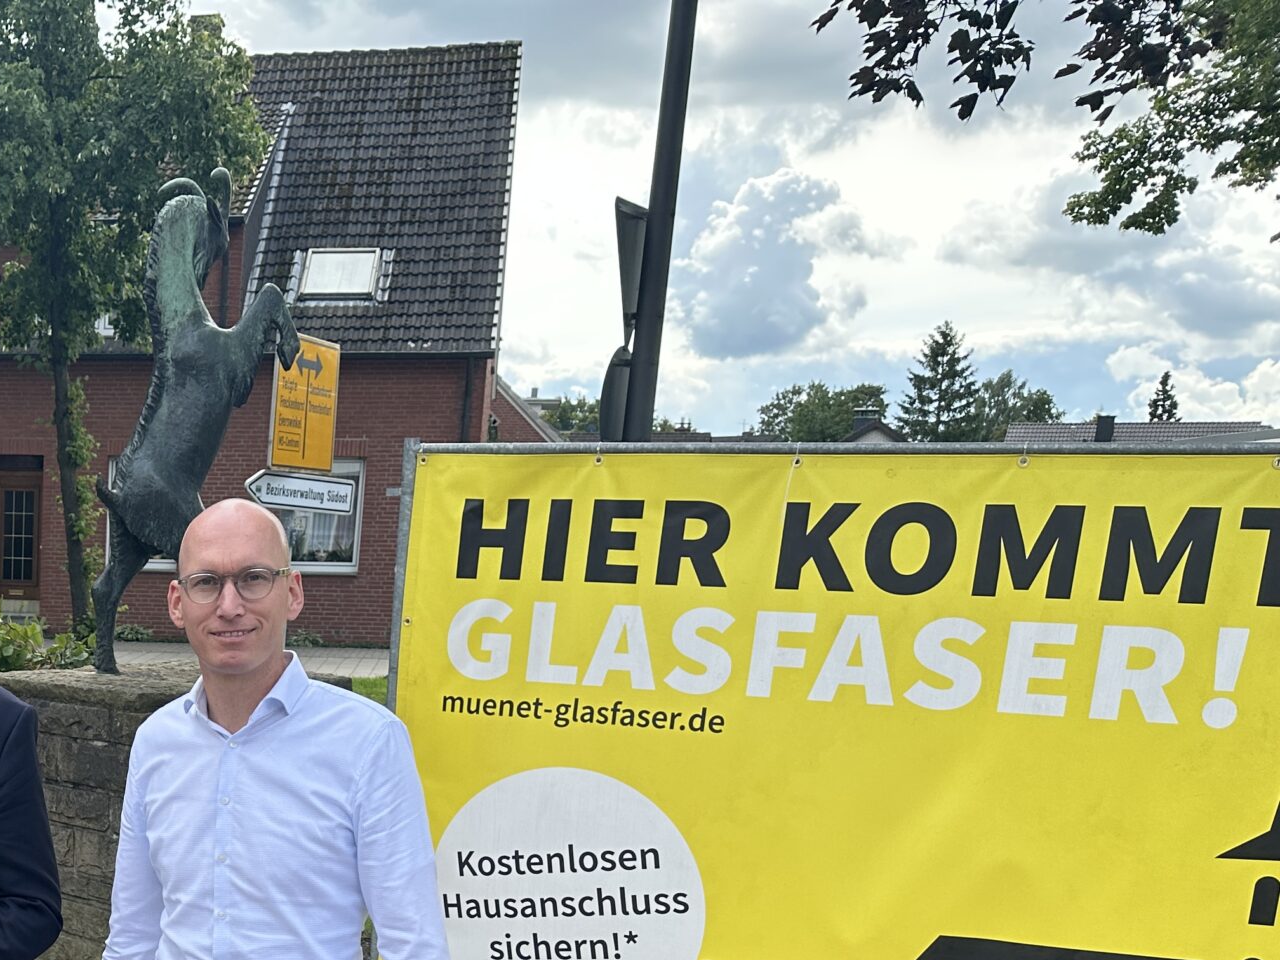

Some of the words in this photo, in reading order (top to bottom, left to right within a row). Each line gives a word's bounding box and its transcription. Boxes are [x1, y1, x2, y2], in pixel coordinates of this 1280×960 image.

[265, 482, 325, 504] Bezirksverwaltung
[327, 490, 348, 504] Südost
[456, 498, 731, 588] HIER
[774, 501, 1280, 608] KOMMT
[447, 598, 1251, 730] GLASFASER!
[441, 694, 725, 734] muenet-glasfaser.de
[457, 843, 661, 877] Kostenlosen
[442, 886, 690, 919] Hausanschluss
